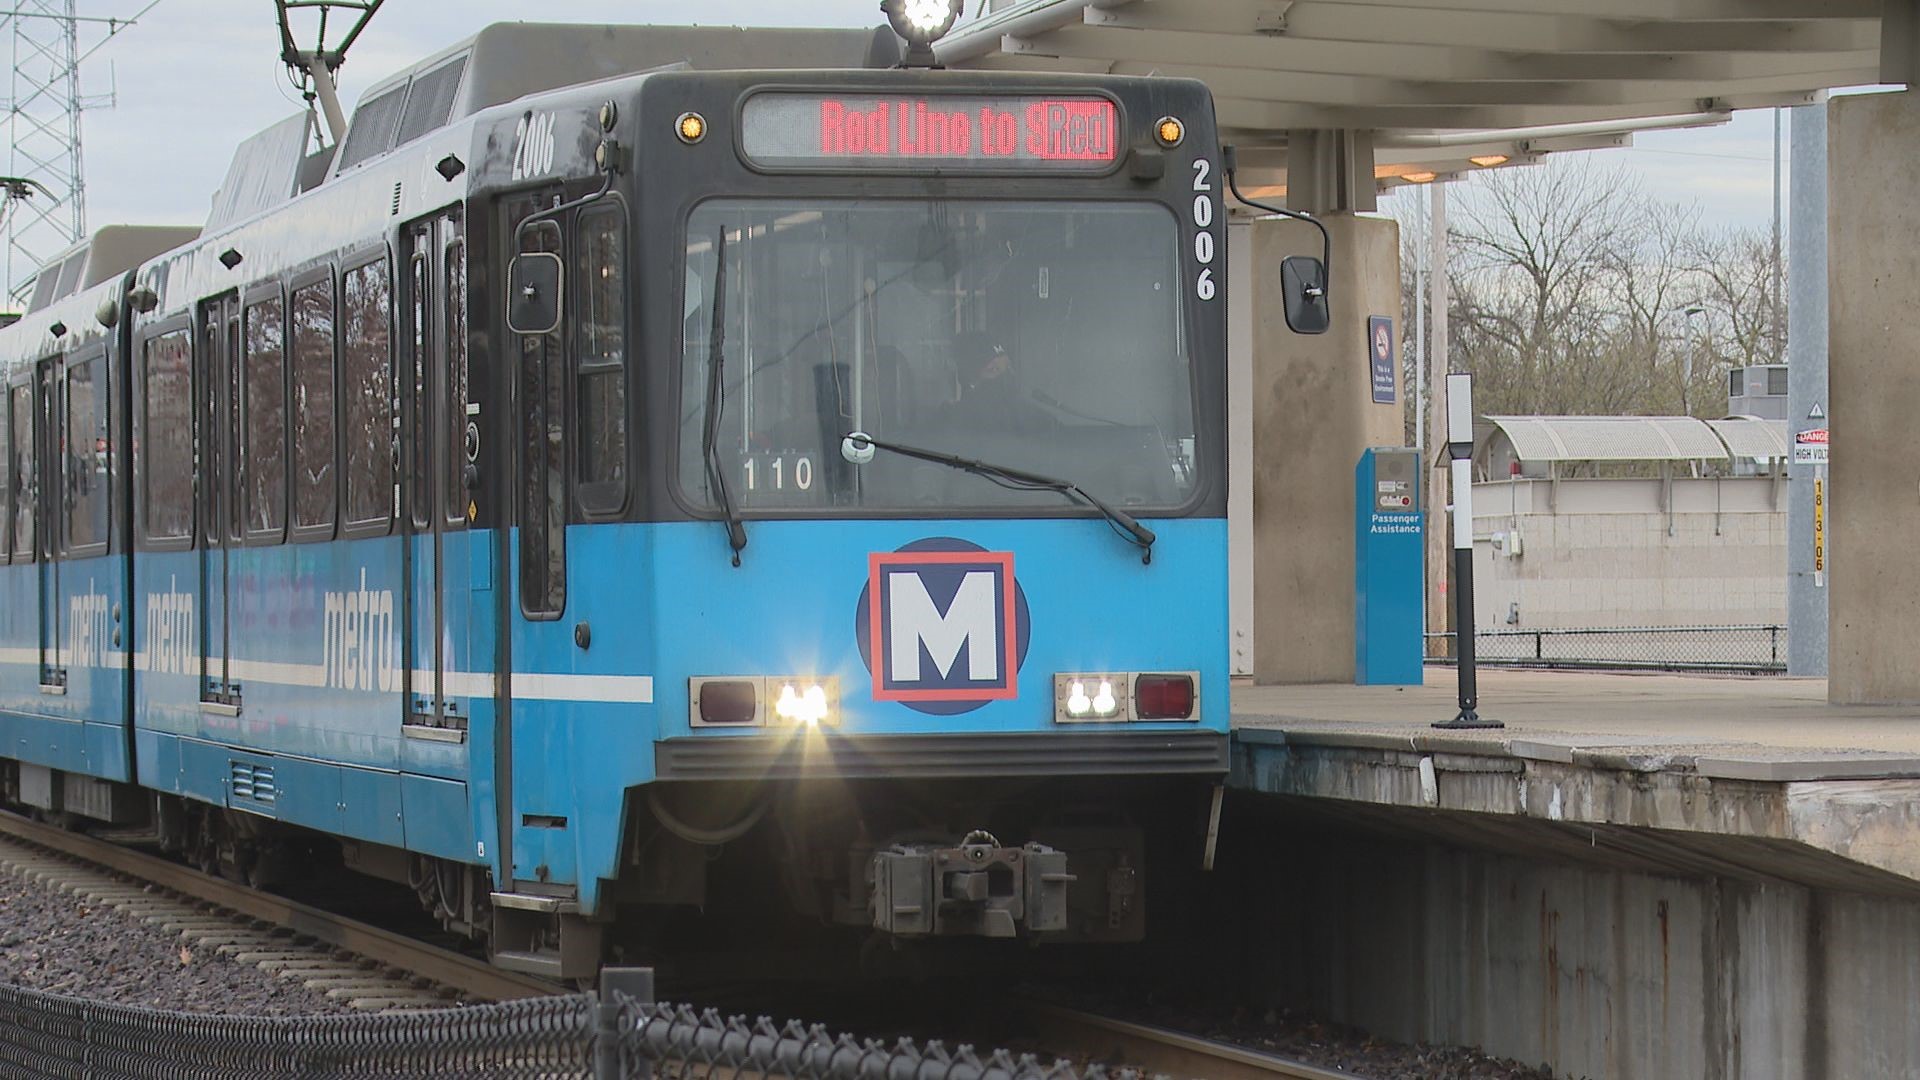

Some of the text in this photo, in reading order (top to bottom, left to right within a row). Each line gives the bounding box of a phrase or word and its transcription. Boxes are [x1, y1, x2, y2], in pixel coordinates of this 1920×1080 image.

[511, 111, 556, 181] 2006
[820, 100, 889, 155] Red
[898, 101, 971, 156] Line
[979, 105, 1018, 156] to
[1191, 159, 1216, 301] 2006
[1795, 448, 1811, 460] HIGH
[1799, 431, 1829, 442] DANGE
[743, 456, 812, 491] 110
[1370, 524, 1421, 534] Assistance
[1371, 514, 1419, 525] Passenger
[70, 576, 109, 668] metro
[146, 573, 194, 675] metro
[322, 566, 394, 692] metro
[888, 571, 998, 683] M
